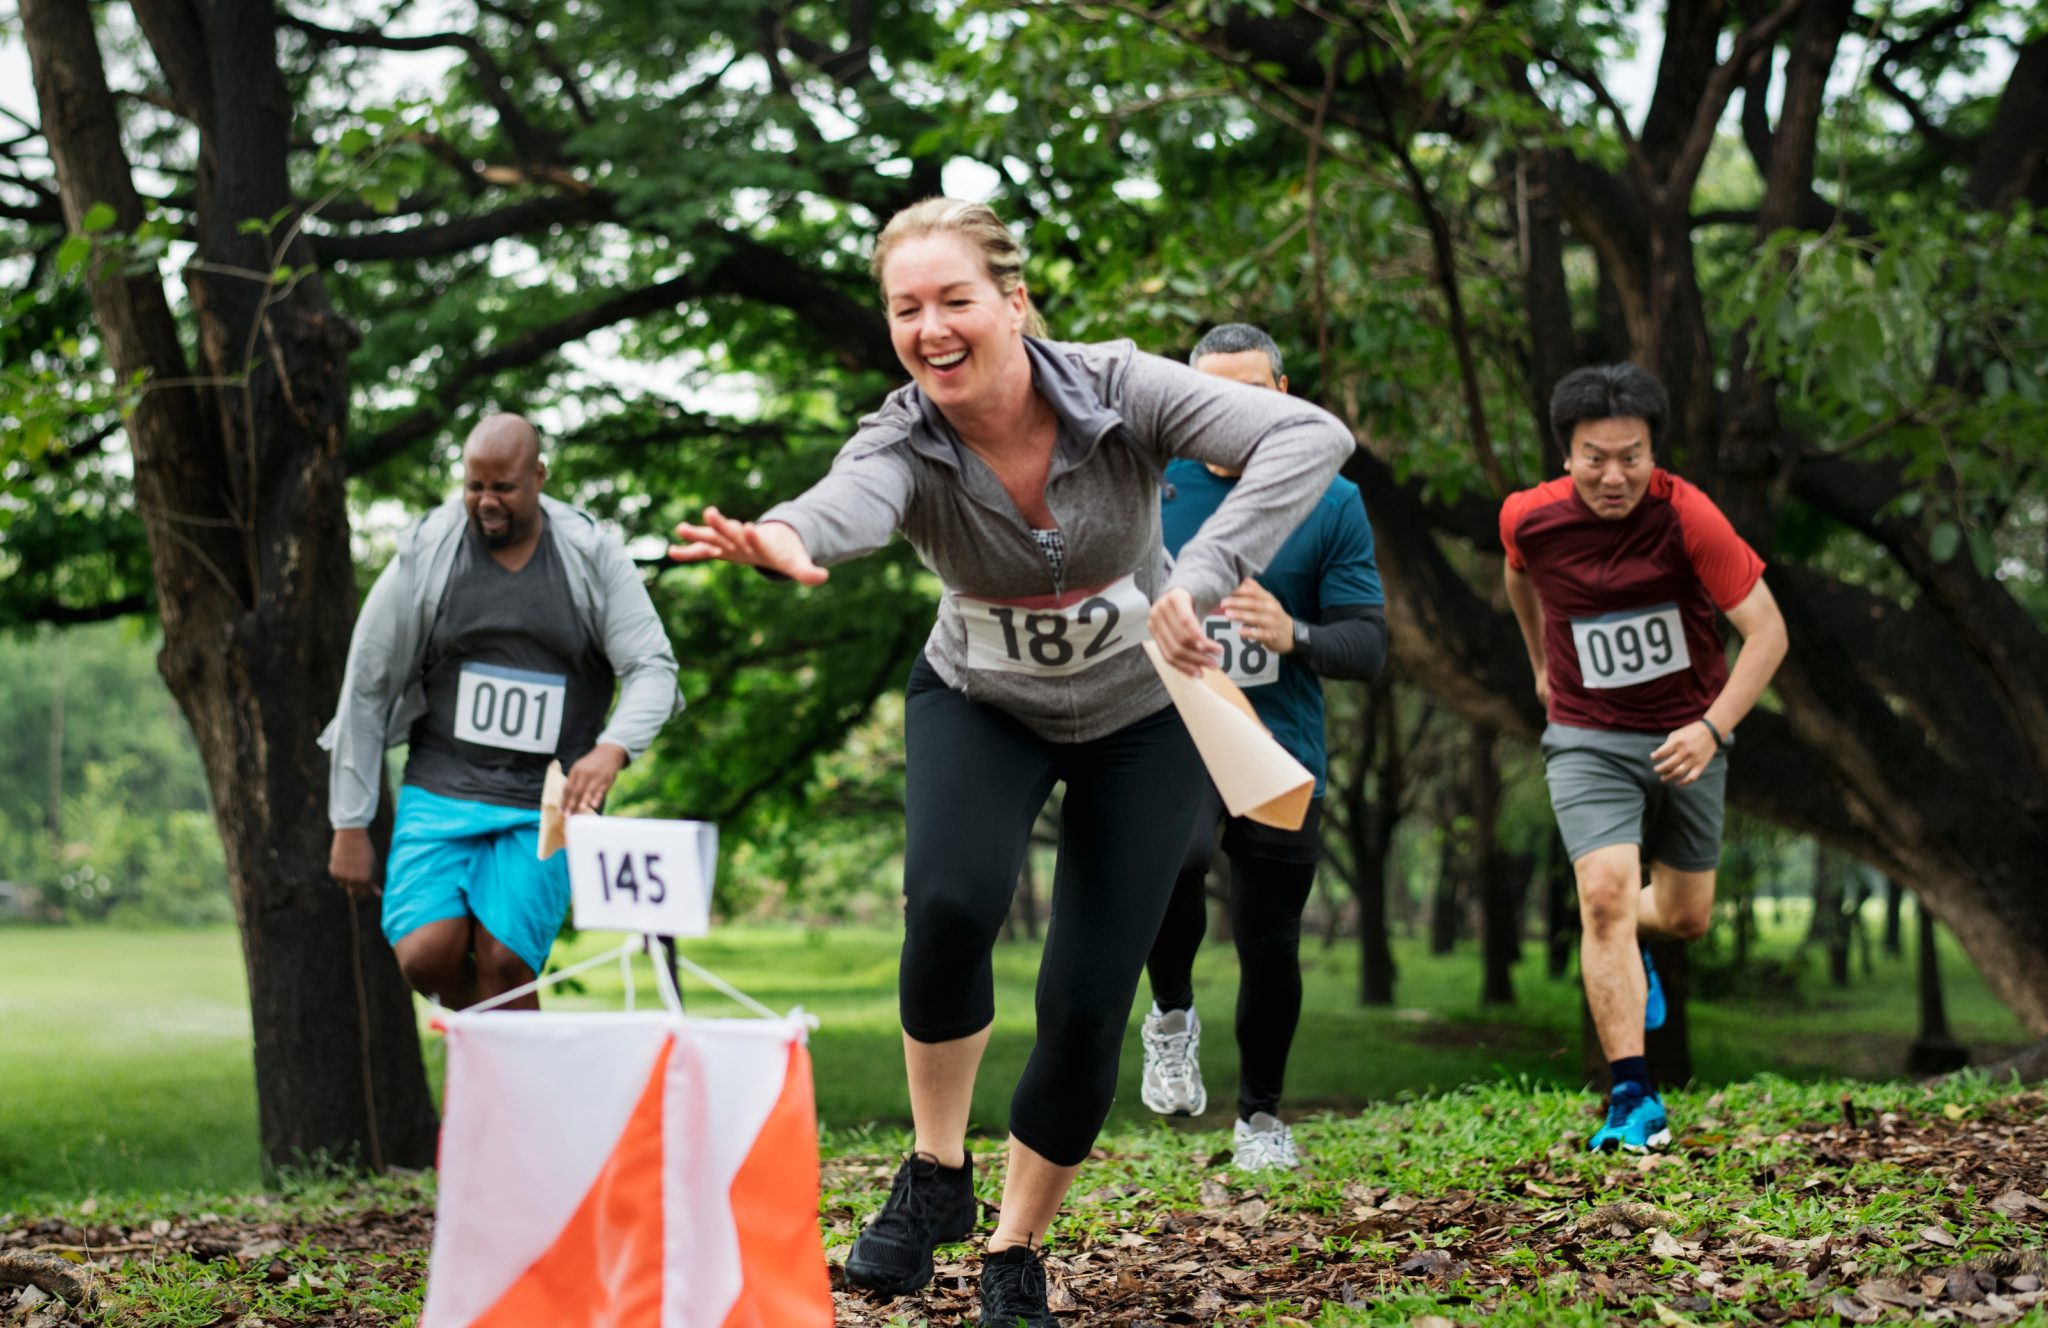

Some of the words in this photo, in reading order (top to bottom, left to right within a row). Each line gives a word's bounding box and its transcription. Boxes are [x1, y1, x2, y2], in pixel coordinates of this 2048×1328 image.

[989, 597, 1122, 666] 182
[1587, 616, 1673, 677] 099
[472, 682, 548, 741] 001
[598, 850, 666, 904] 145
